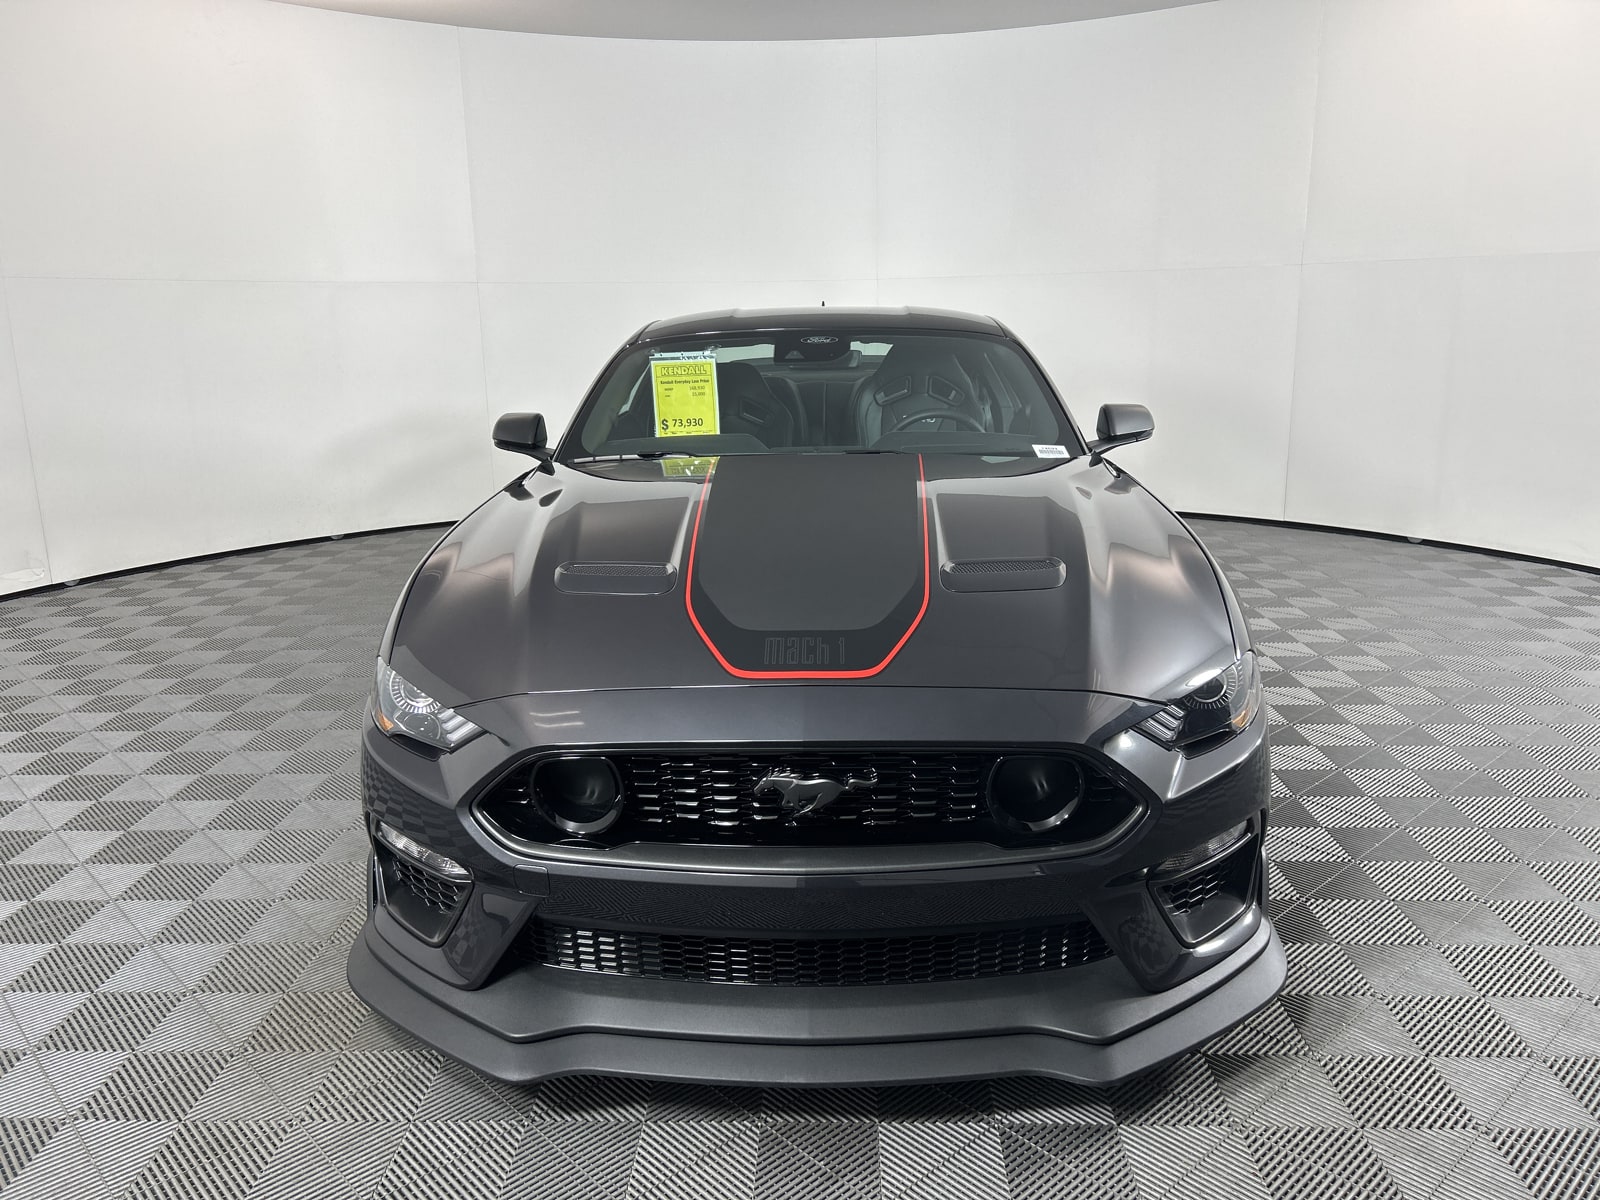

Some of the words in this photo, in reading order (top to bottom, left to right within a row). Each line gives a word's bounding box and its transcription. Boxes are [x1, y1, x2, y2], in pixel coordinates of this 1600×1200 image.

[661, 365, 707, 376] KENDALL
[661, 418, 668, 432] $
[672, 418, 704, 428] 73,930
[838, 637, 845, 664] 1
